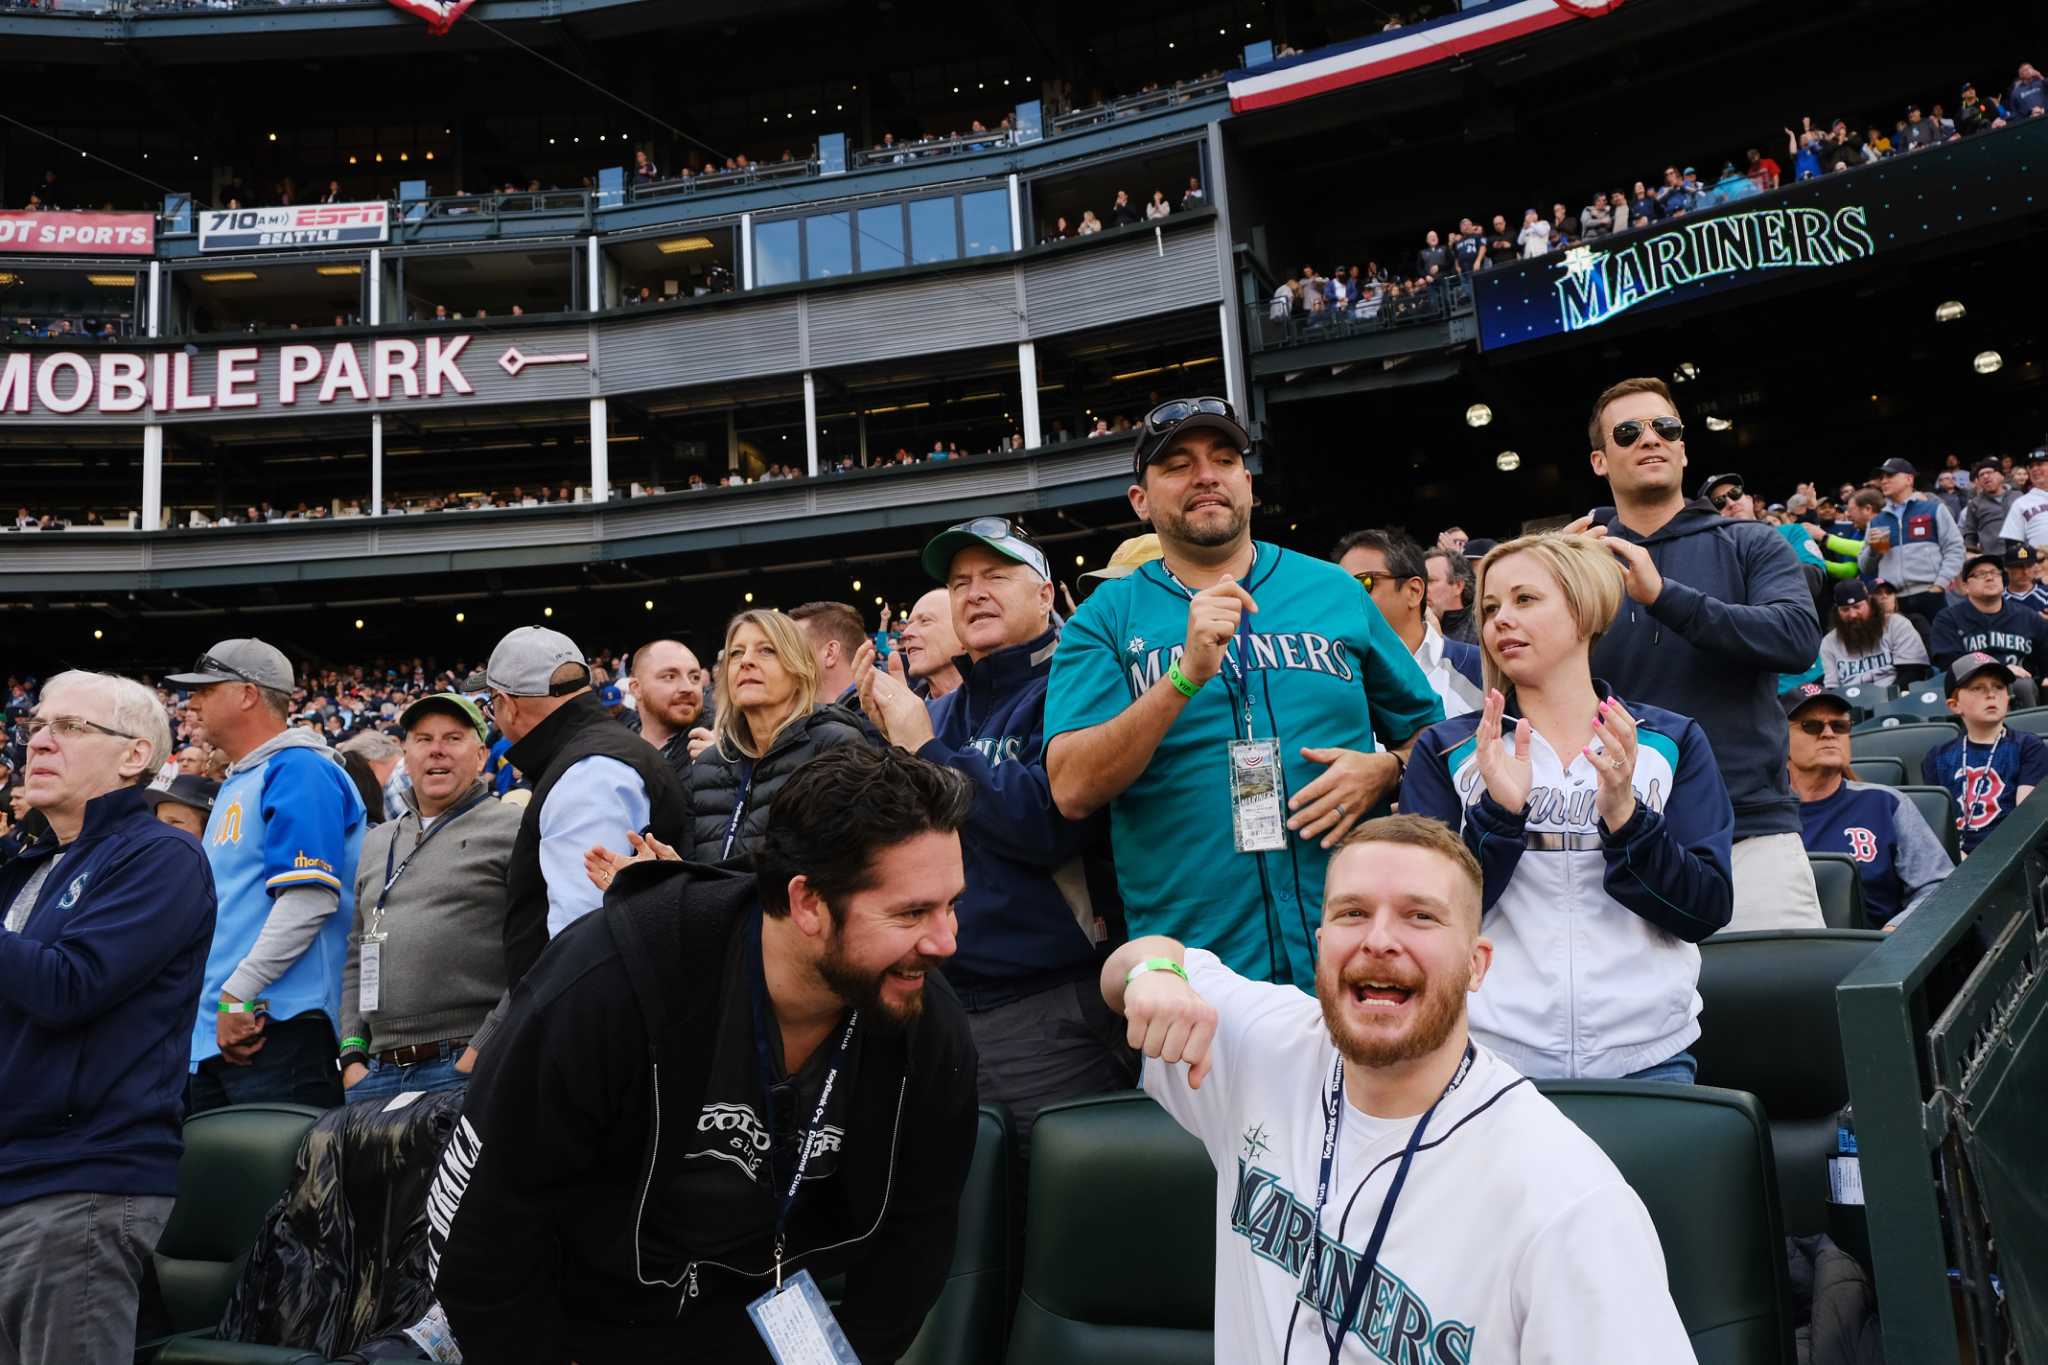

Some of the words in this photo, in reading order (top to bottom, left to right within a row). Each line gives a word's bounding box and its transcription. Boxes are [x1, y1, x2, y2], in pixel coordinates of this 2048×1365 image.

[38, 224, 147, 245] SPORTS
[210, 212, 258, 231] 710
[296, 204, 384, 226] ESPN
[258, 229, 339, 246] SEATTLE
[1554, 206, 1874, 332] MARINERS
[279, 335, 474, 404] PARK
[1962, 630, 2033, 655] ARINERS
[1954, 766, 2006, 832] B
[1844, 827, 1878, 862] B
[819, 1068, 838, 1107] KeyBank
[798, 1130, 817, 1172] Diamond
[1322, 1117, 1337, 1160] KeyBank
[426, 1114, 484, 1243] BRANCA
[788, 1173, 802, 1197] Club
